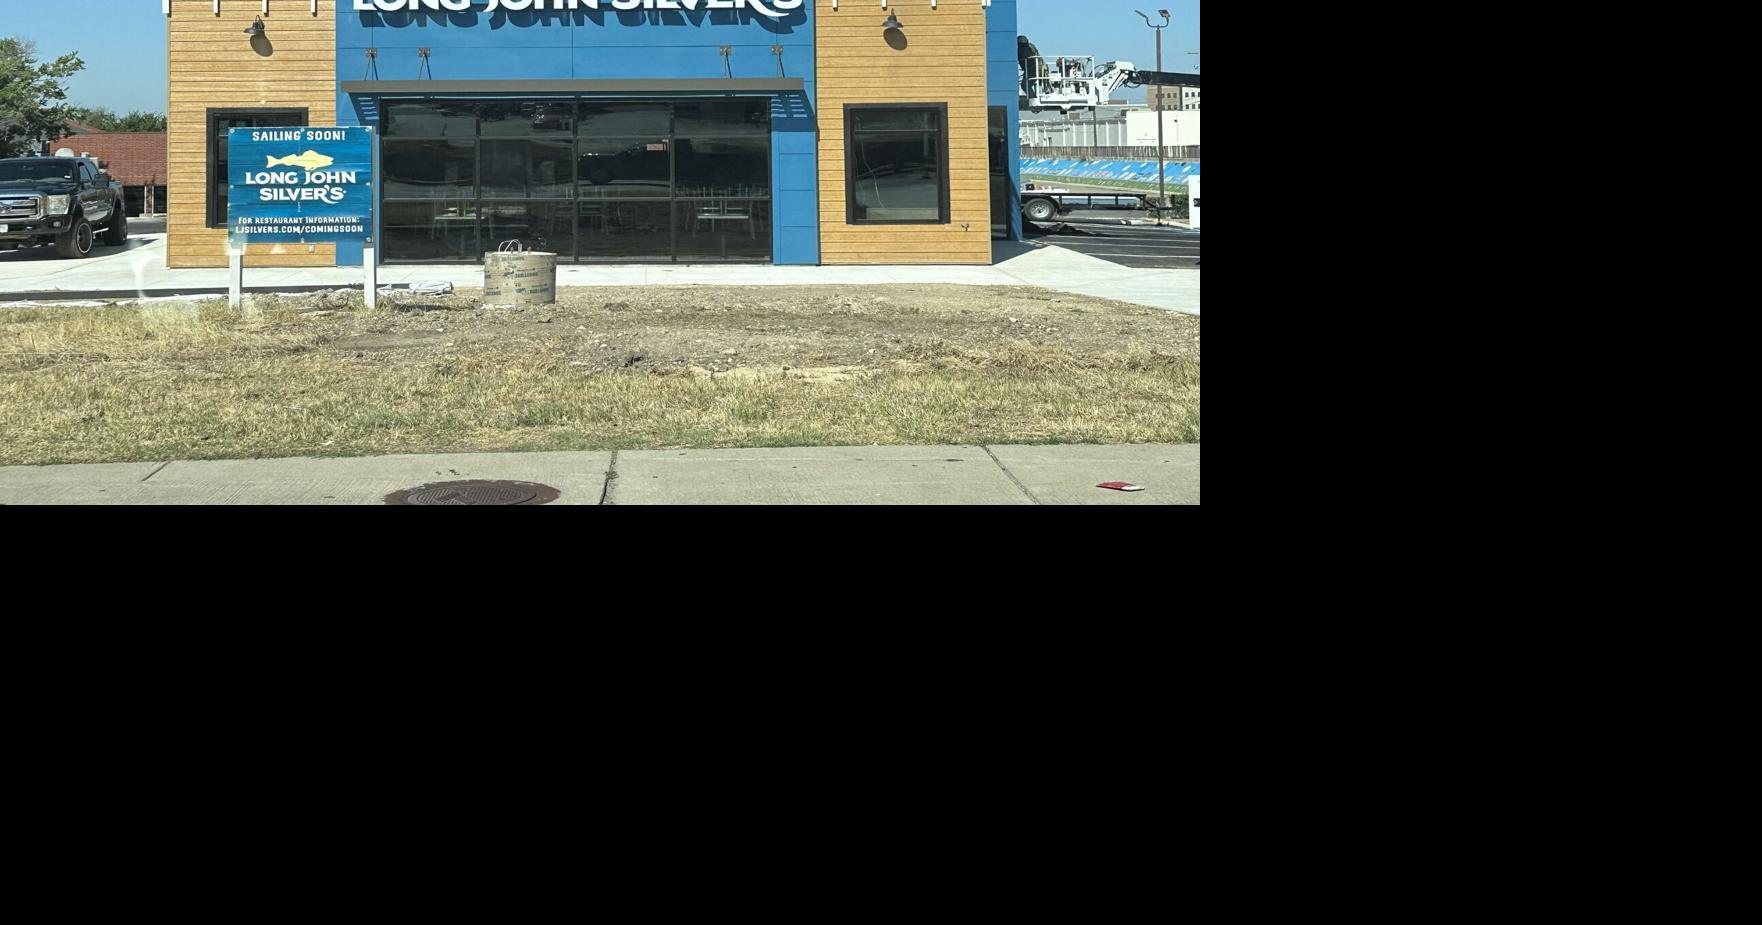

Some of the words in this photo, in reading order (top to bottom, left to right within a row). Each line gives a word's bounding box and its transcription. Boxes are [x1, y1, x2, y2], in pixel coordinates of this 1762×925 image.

[252, 131, 301, 141] SAILING
[306, 130, 346, 141] SOON!
[245, 171, 298, 184] LONG
[304, 171, 356, 184] JOHN
[260, 185, 345, 205] SILVER'S
[238, 216, 254, 224] FOR
[255, 216, 303, 224] RESTAURANT
[305, 216, 360, 224] INFORMATION:
[235, 225, 363, 234] LJSILVERS.COM/COMINGSOON
